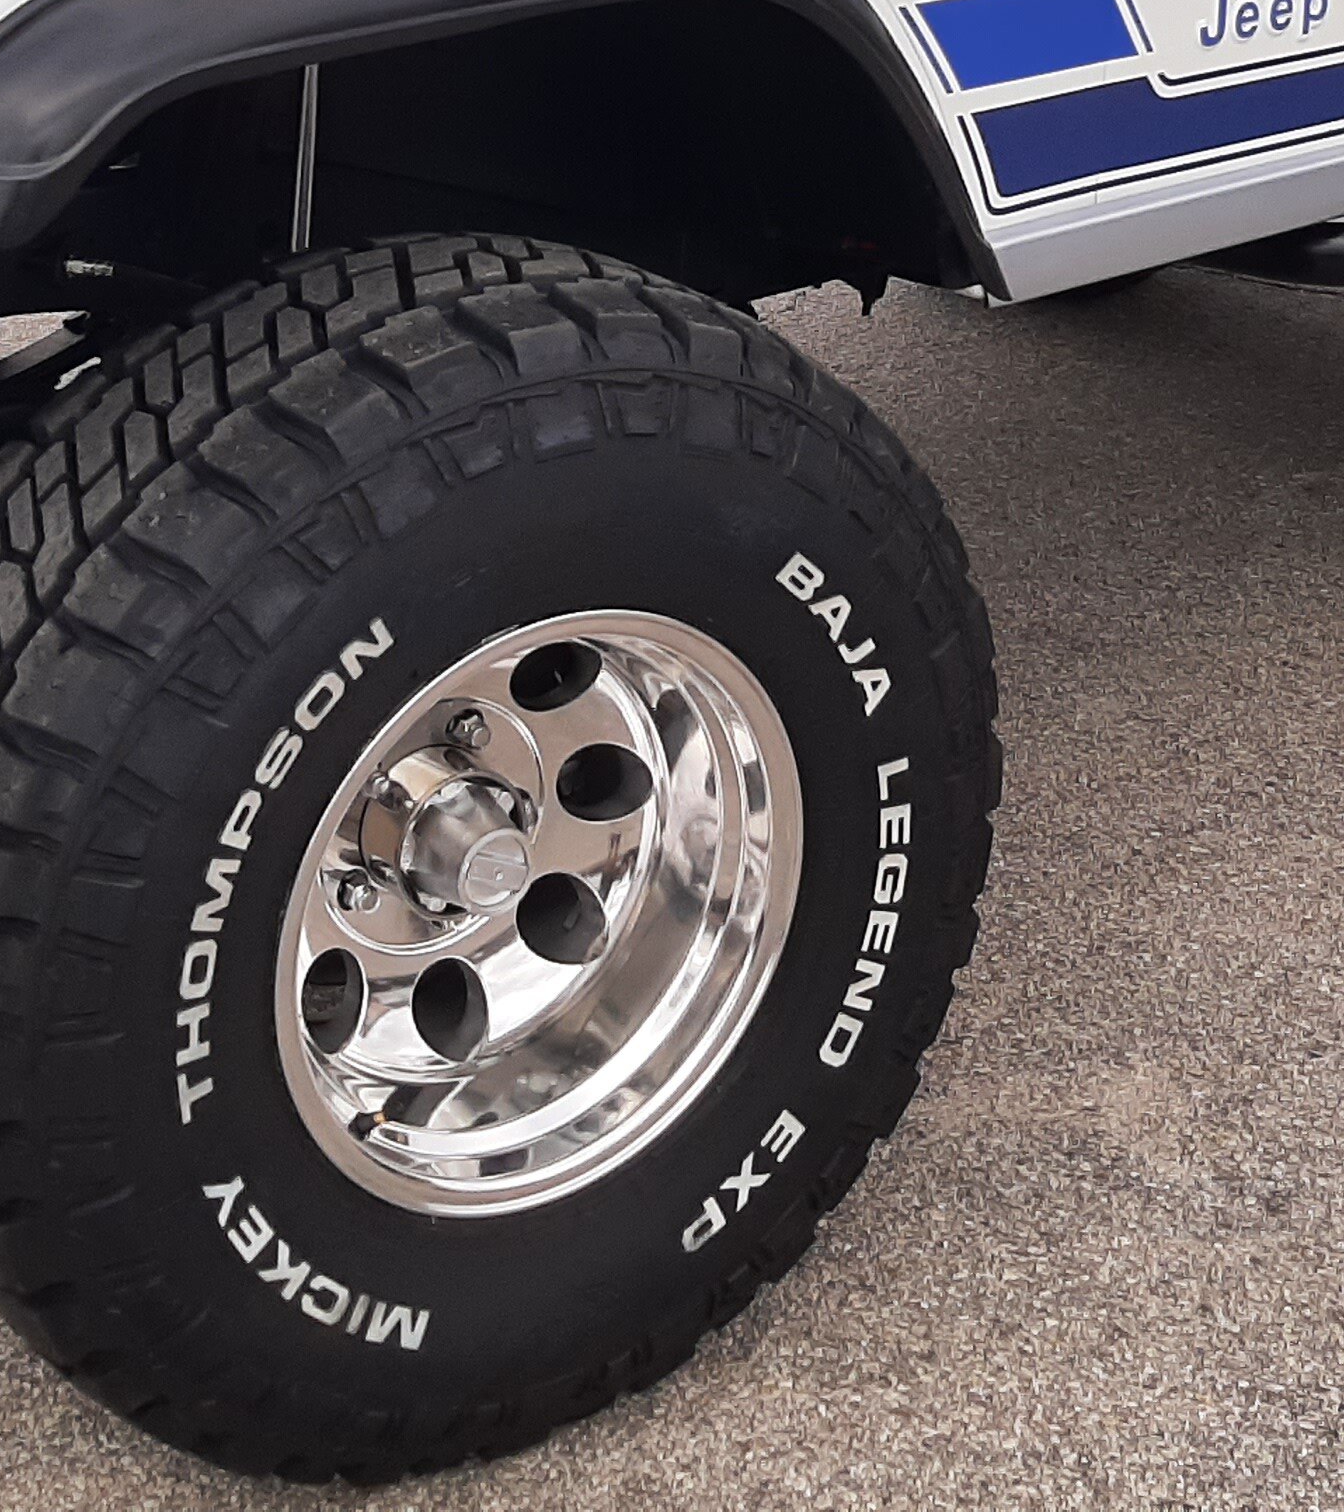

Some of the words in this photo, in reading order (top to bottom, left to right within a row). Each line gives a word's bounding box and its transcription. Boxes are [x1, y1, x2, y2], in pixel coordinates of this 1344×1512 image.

[774, 551, 893, 718] BAJA
[175, 616, 397, 1123] THOMPSON
[819, 756, 912, 1069] LEGEND
[203, 1174, 433, 1352] MICKEY
[681, 1108, 807, 1254] EXP
